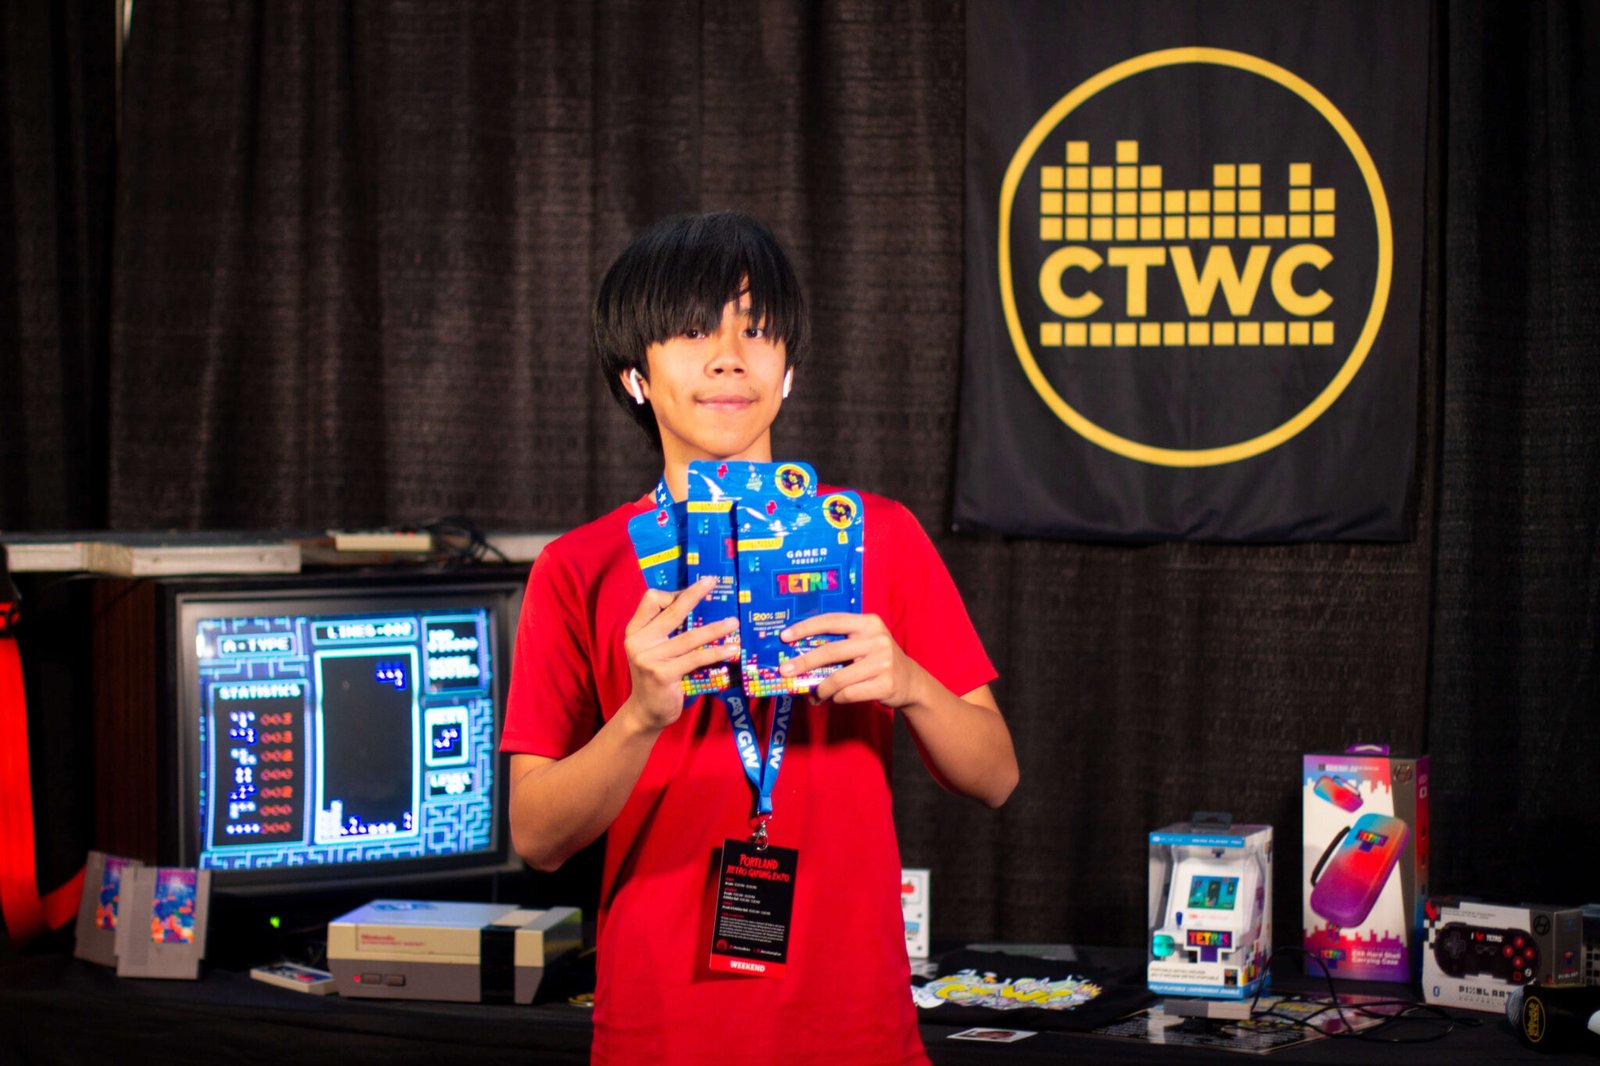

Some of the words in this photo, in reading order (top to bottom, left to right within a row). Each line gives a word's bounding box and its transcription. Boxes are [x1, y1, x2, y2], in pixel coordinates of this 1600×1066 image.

[1039, 243, 1334, 318] CTWC
[786, 547, 828, 559] GAMER
[776, 570, 838, 594] TETRIS
[753, 612, 773, 622] 20%
[219, 686, 302, 700] STATISTICS
[733, 713, 760, 769] VGW
[739, 853, 779, 870] PORTLAND
[726, 864, 748, 877] RETRO
[772, 871, 790, 883] EXPO
[1189, 931, 1230, 946] TETRIS
[1486, 934, 1504, 943] TETRIS
[730, 960, 766, 973] WEEKEND
[1458, 985, 1489, 996] PIXEL
